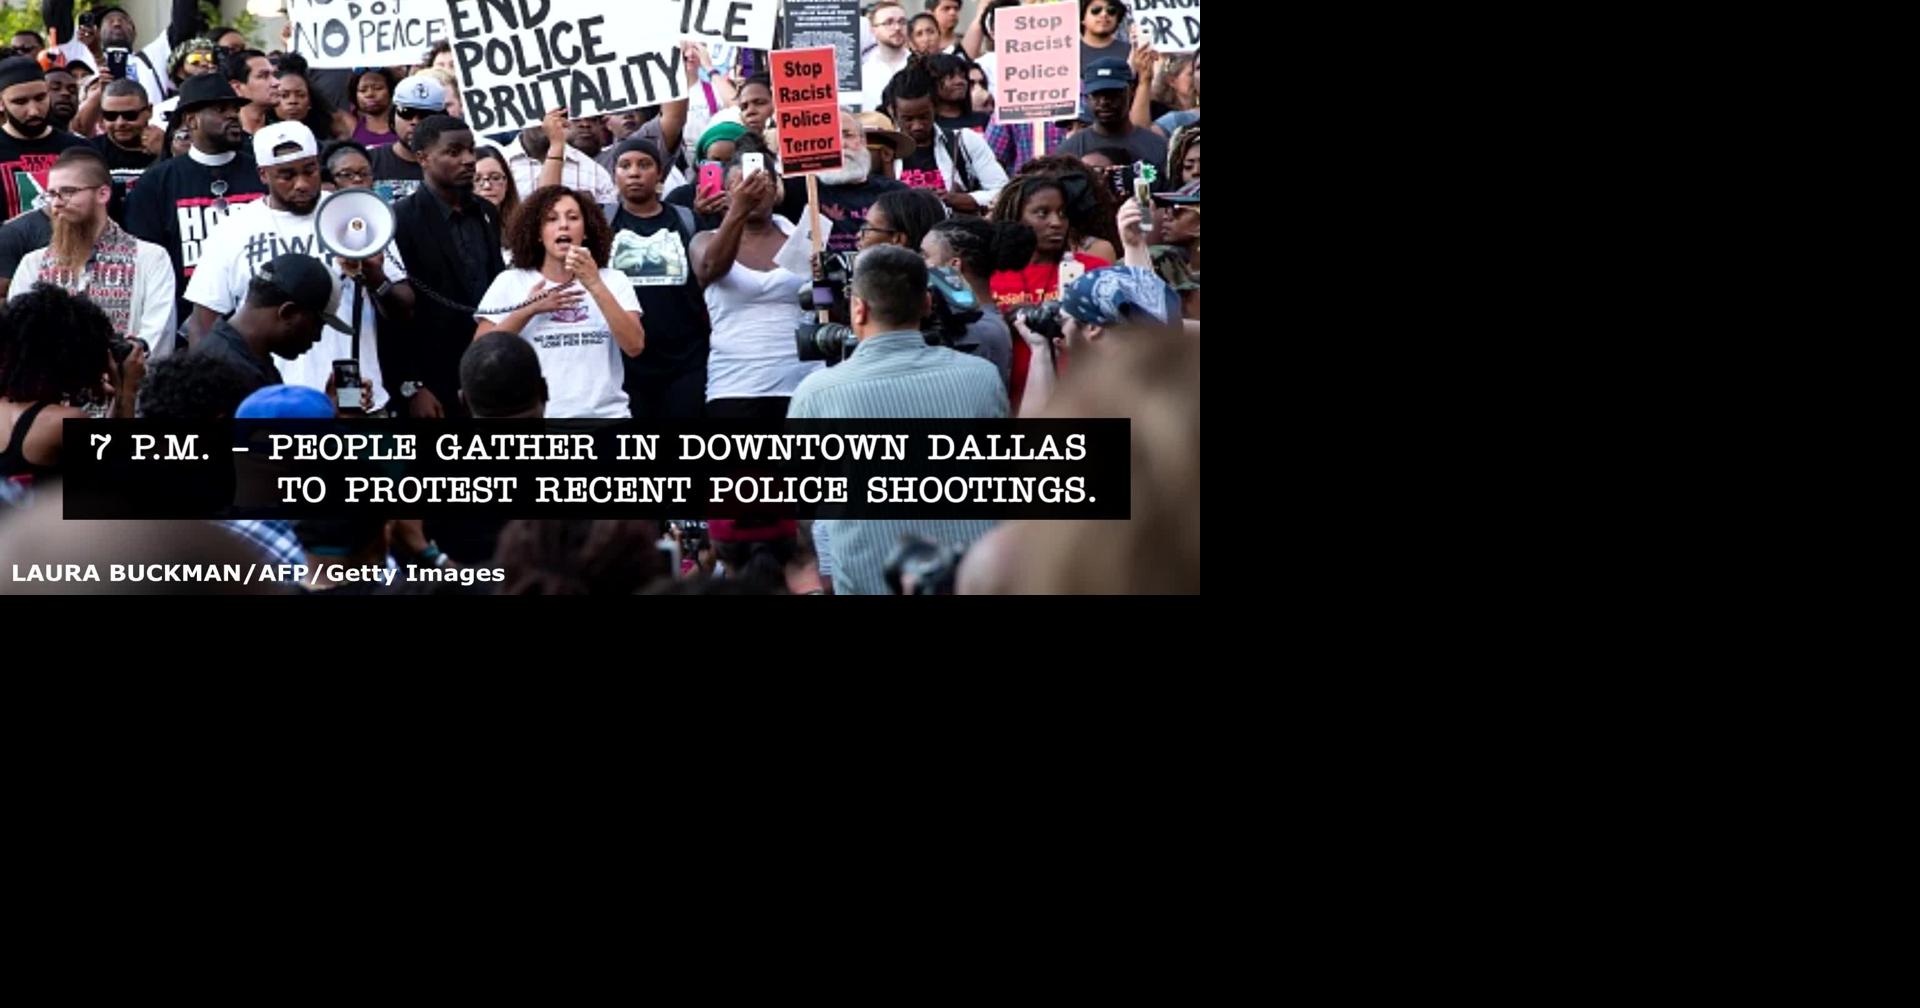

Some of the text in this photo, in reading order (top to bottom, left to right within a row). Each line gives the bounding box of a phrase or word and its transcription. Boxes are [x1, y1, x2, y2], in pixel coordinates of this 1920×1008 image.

[348, 1, 399, 20] DOJ
[449, 0, 550, 39] END
[673, 0, 753, 42] ILE
[1014, 16, 1063, 31] Stop
[293, 18, 445, 59] NO PEACE
[1005, 35, 1073, 54] Racist
[453, 15, 616, 87] POLICE
[784, 61, 823, 78] Stop
[1005, 64, 1069, 81] Police
[463, 46, 681, 131] BRUTALITY
[779, 84, 833, 103] Racist
[1003, 87, 1070, 103] Terror
[781, 111, 832, 129] Police
[783, 136, 834, 154] Terror
